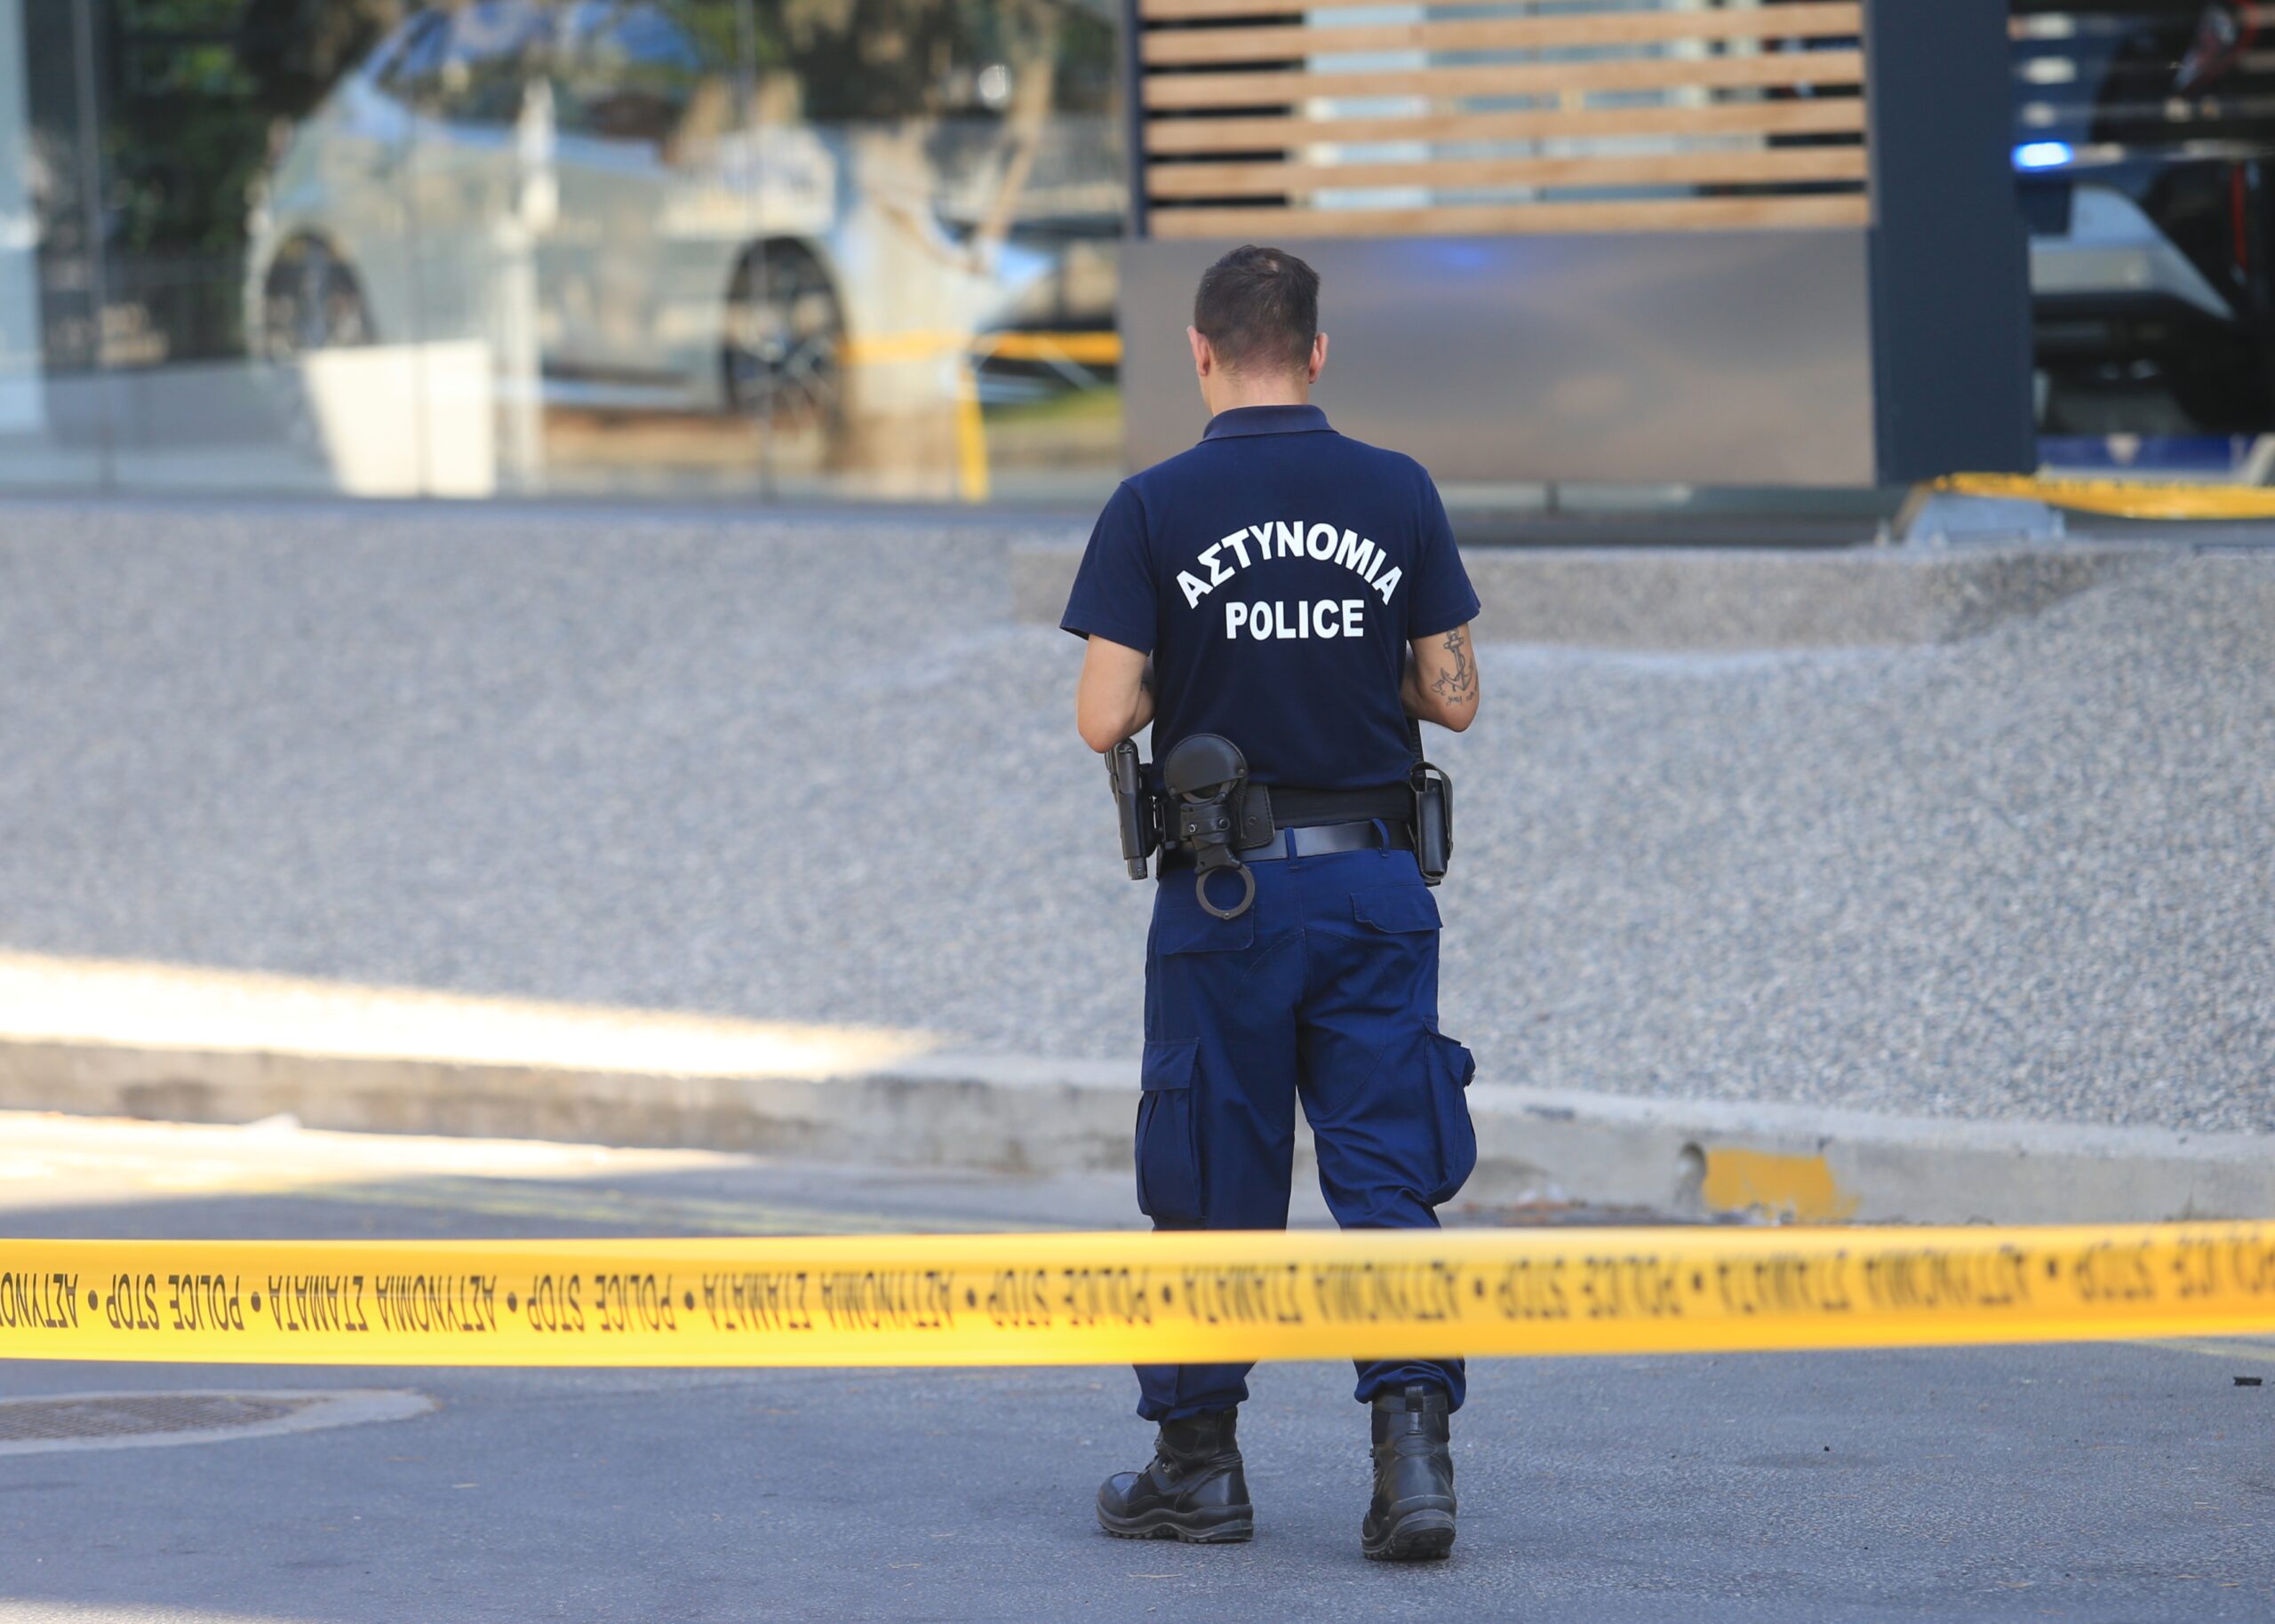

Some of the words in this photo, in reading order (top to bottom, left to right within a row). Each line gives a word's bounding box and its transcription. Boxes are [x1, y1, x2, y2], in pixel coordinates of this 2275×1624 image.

[1177, 521, 1402, 609] ΑΣΤΥΝΟΜΙΑ
[1225, 600, 1364, 641] POLICE
[0, 1271, 79, 1328] ΑΣΤΥΝΟ
[106, 1272, 160, 1330] STOP
[169, 1274, 244, 1331] POLICE
[268, 1274, 369, 1332] ΣΤΑΜΑΤΑ
[376, 1275, 498, 1332] ΑΣΤΥΝΟΜΙΑ
[528, 1274, 586, 1332] STOP
[595, 1273, 676, 1332] POLICE
[703, 1271, 813, 1332] ΣΤΑΜΑΤΑ
[819, 1270, 954, 1330] ΑΣΤΥΝΟΜΙΑ
[986, 1268, 1052, 1328] STOP
[1063, 1266, 1152, 1327] POLICE
